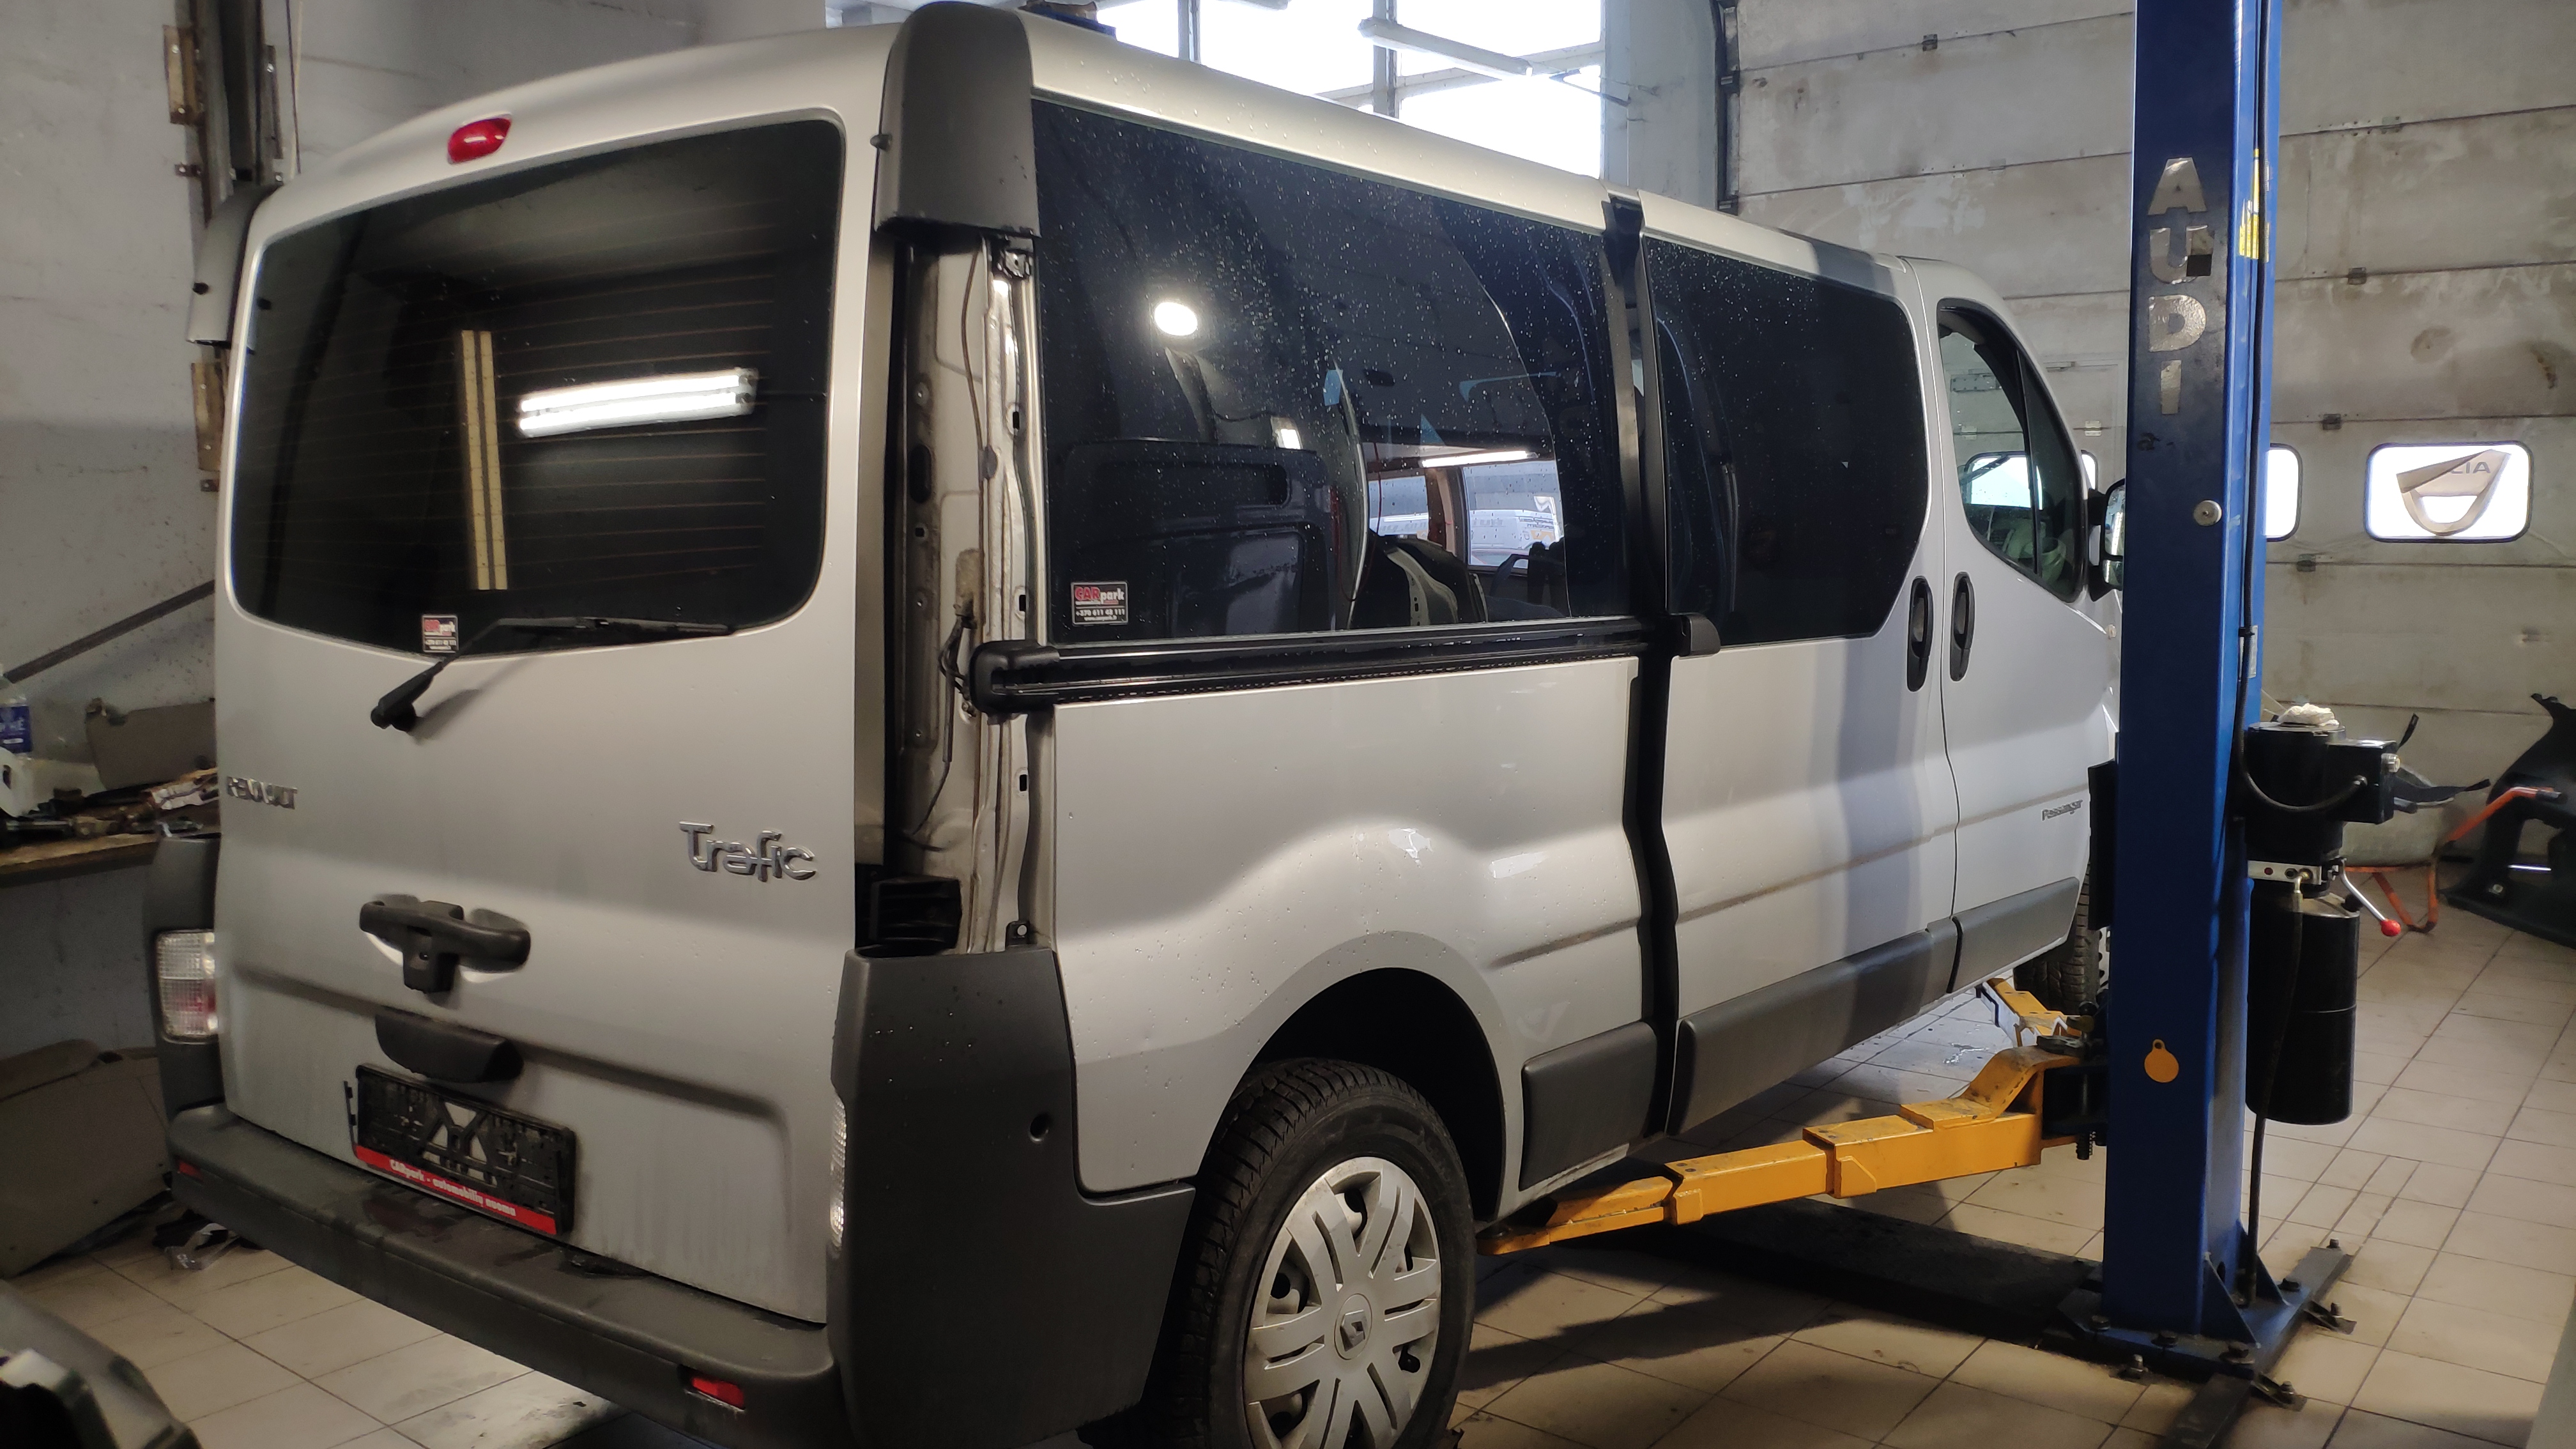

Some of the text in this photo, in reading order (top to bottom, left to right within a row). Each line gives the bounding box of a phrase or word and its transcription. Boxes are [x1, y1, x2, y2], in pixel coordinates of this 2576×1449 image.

[2147, 158, 2215, 415] AUDI
[1075, 586, 1124, 604] CARpark
[679, 820, 817, 882] Trafic
[390, 1159, 425, 1181] CARpark
